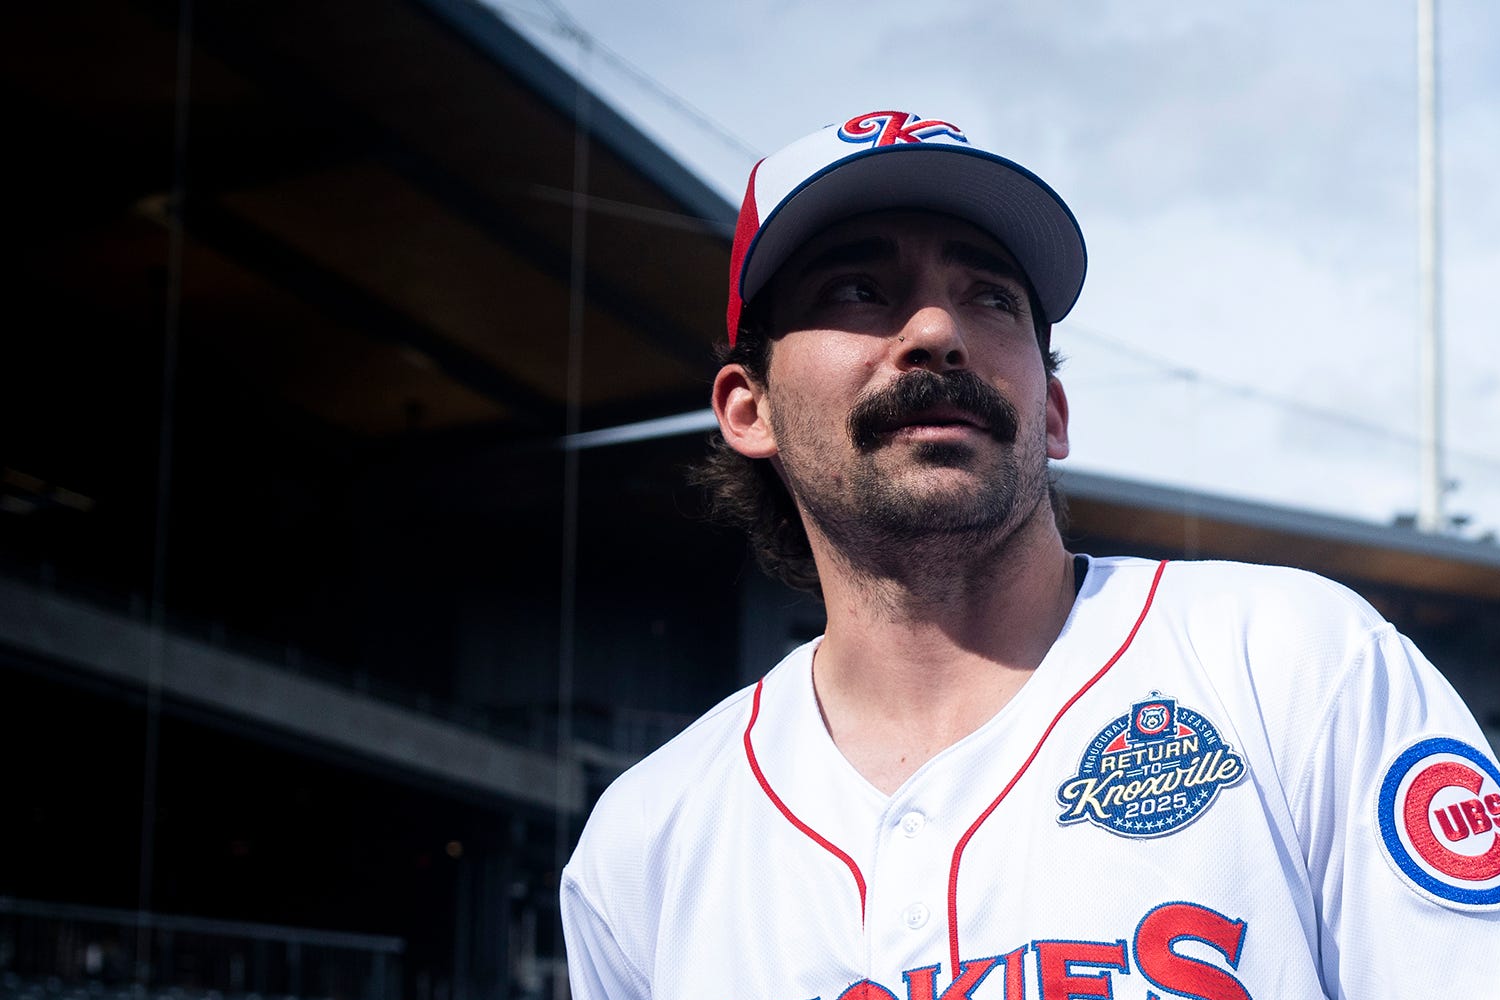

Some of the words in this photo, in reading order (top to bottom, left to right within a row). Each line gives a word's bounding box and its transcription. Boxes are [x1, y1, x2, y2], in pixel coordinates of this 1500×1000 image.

[1083, 720, 1127, 774] INAUGURAL
[1180, 711, 1217, 745] SEASON
[1100, 736, 1199, 774] RETURN
[1062, 749, 1240, 819] Knoxville
[1140, 762, 1162, 776] TO
[1124, 792, 1188, 819] 2025
